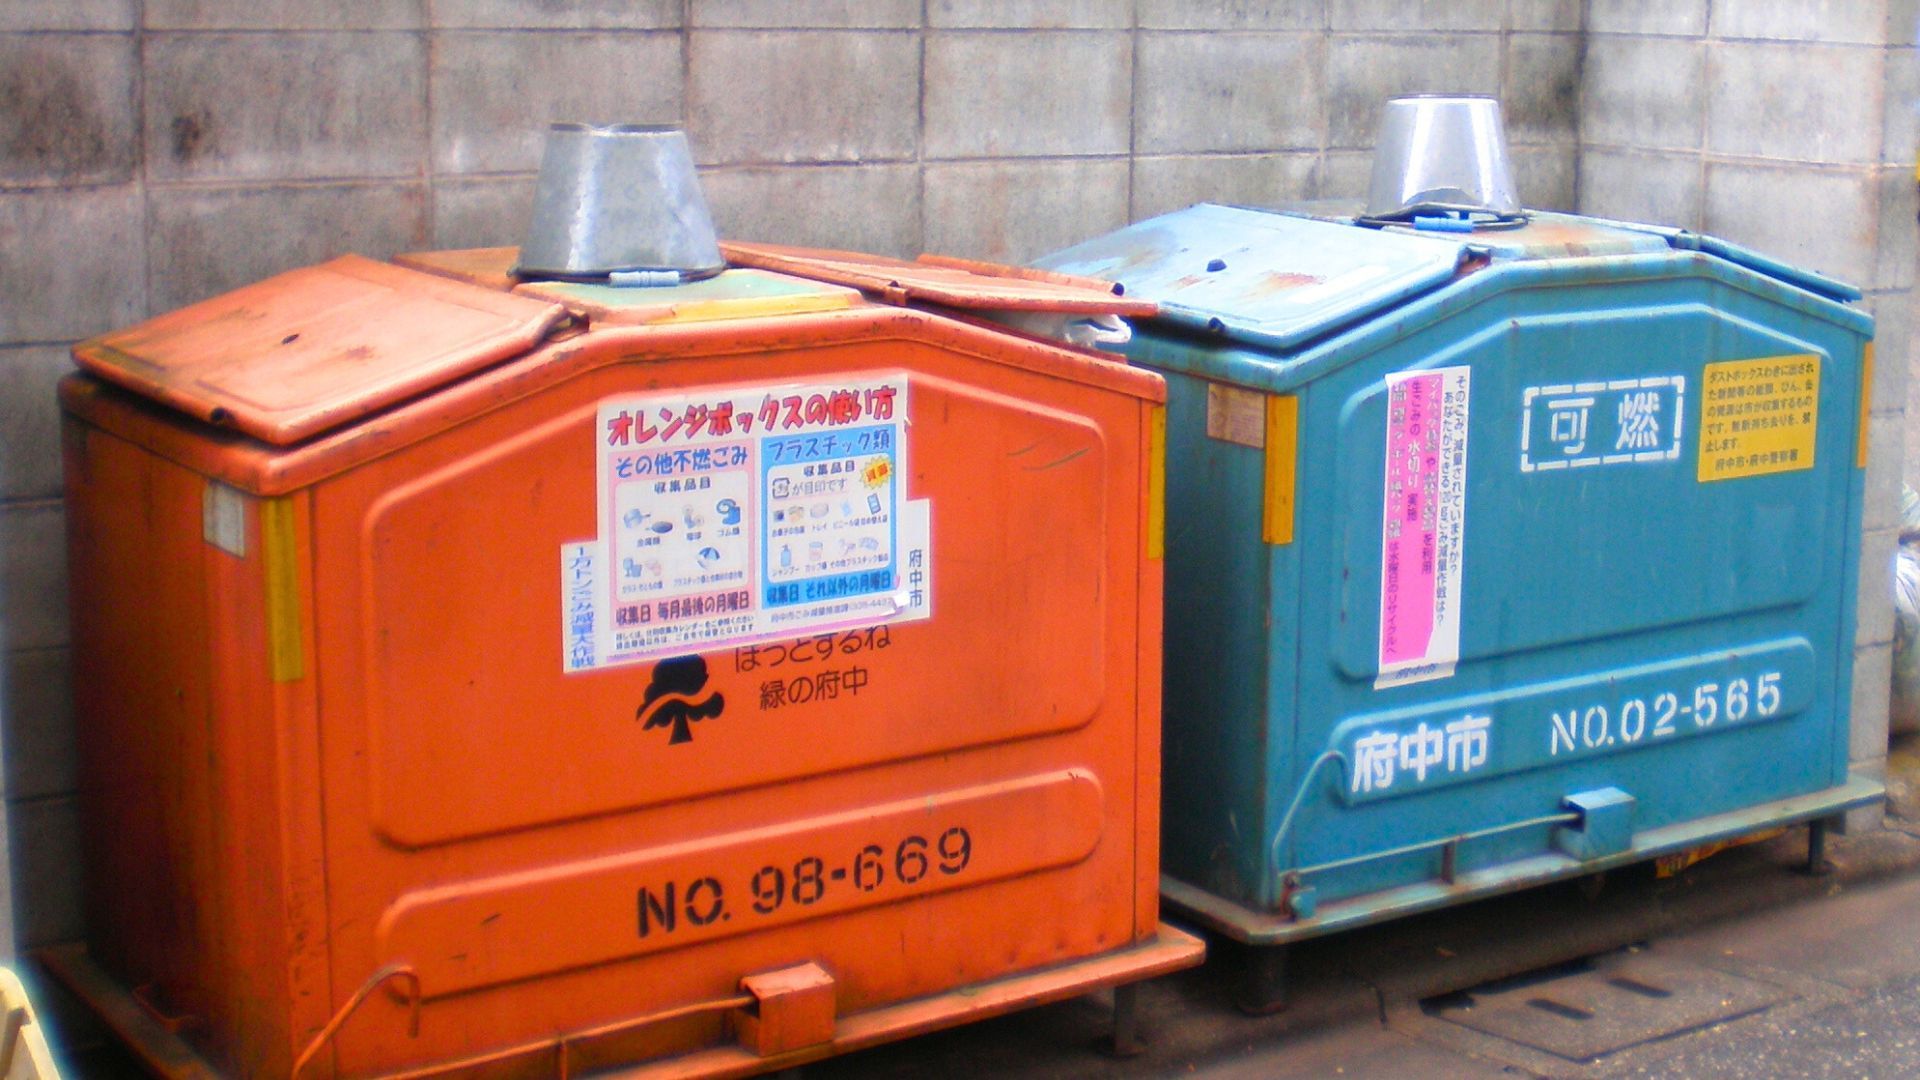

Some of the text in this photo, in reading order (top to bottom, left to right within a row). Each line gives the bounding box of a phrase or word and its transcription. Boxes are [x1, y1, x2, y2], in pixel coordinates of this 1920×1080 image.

[607, 385, 897, 446] オレンジボックスの使い方
[1548, 391, 1660, 454] 可燃
[616, 445, 748, 478] その他不燃ごみ
[654, 477, 711, 494] 収集品目
[803, 460, 855, 477] 収集品目
[908, 548, 923, 609] 府中市
[760, 665, 868, 711] 緑の府中
[1352, 714, 1492, 793] 府中市
[637, 827, 972, 938] NO. 98-669
